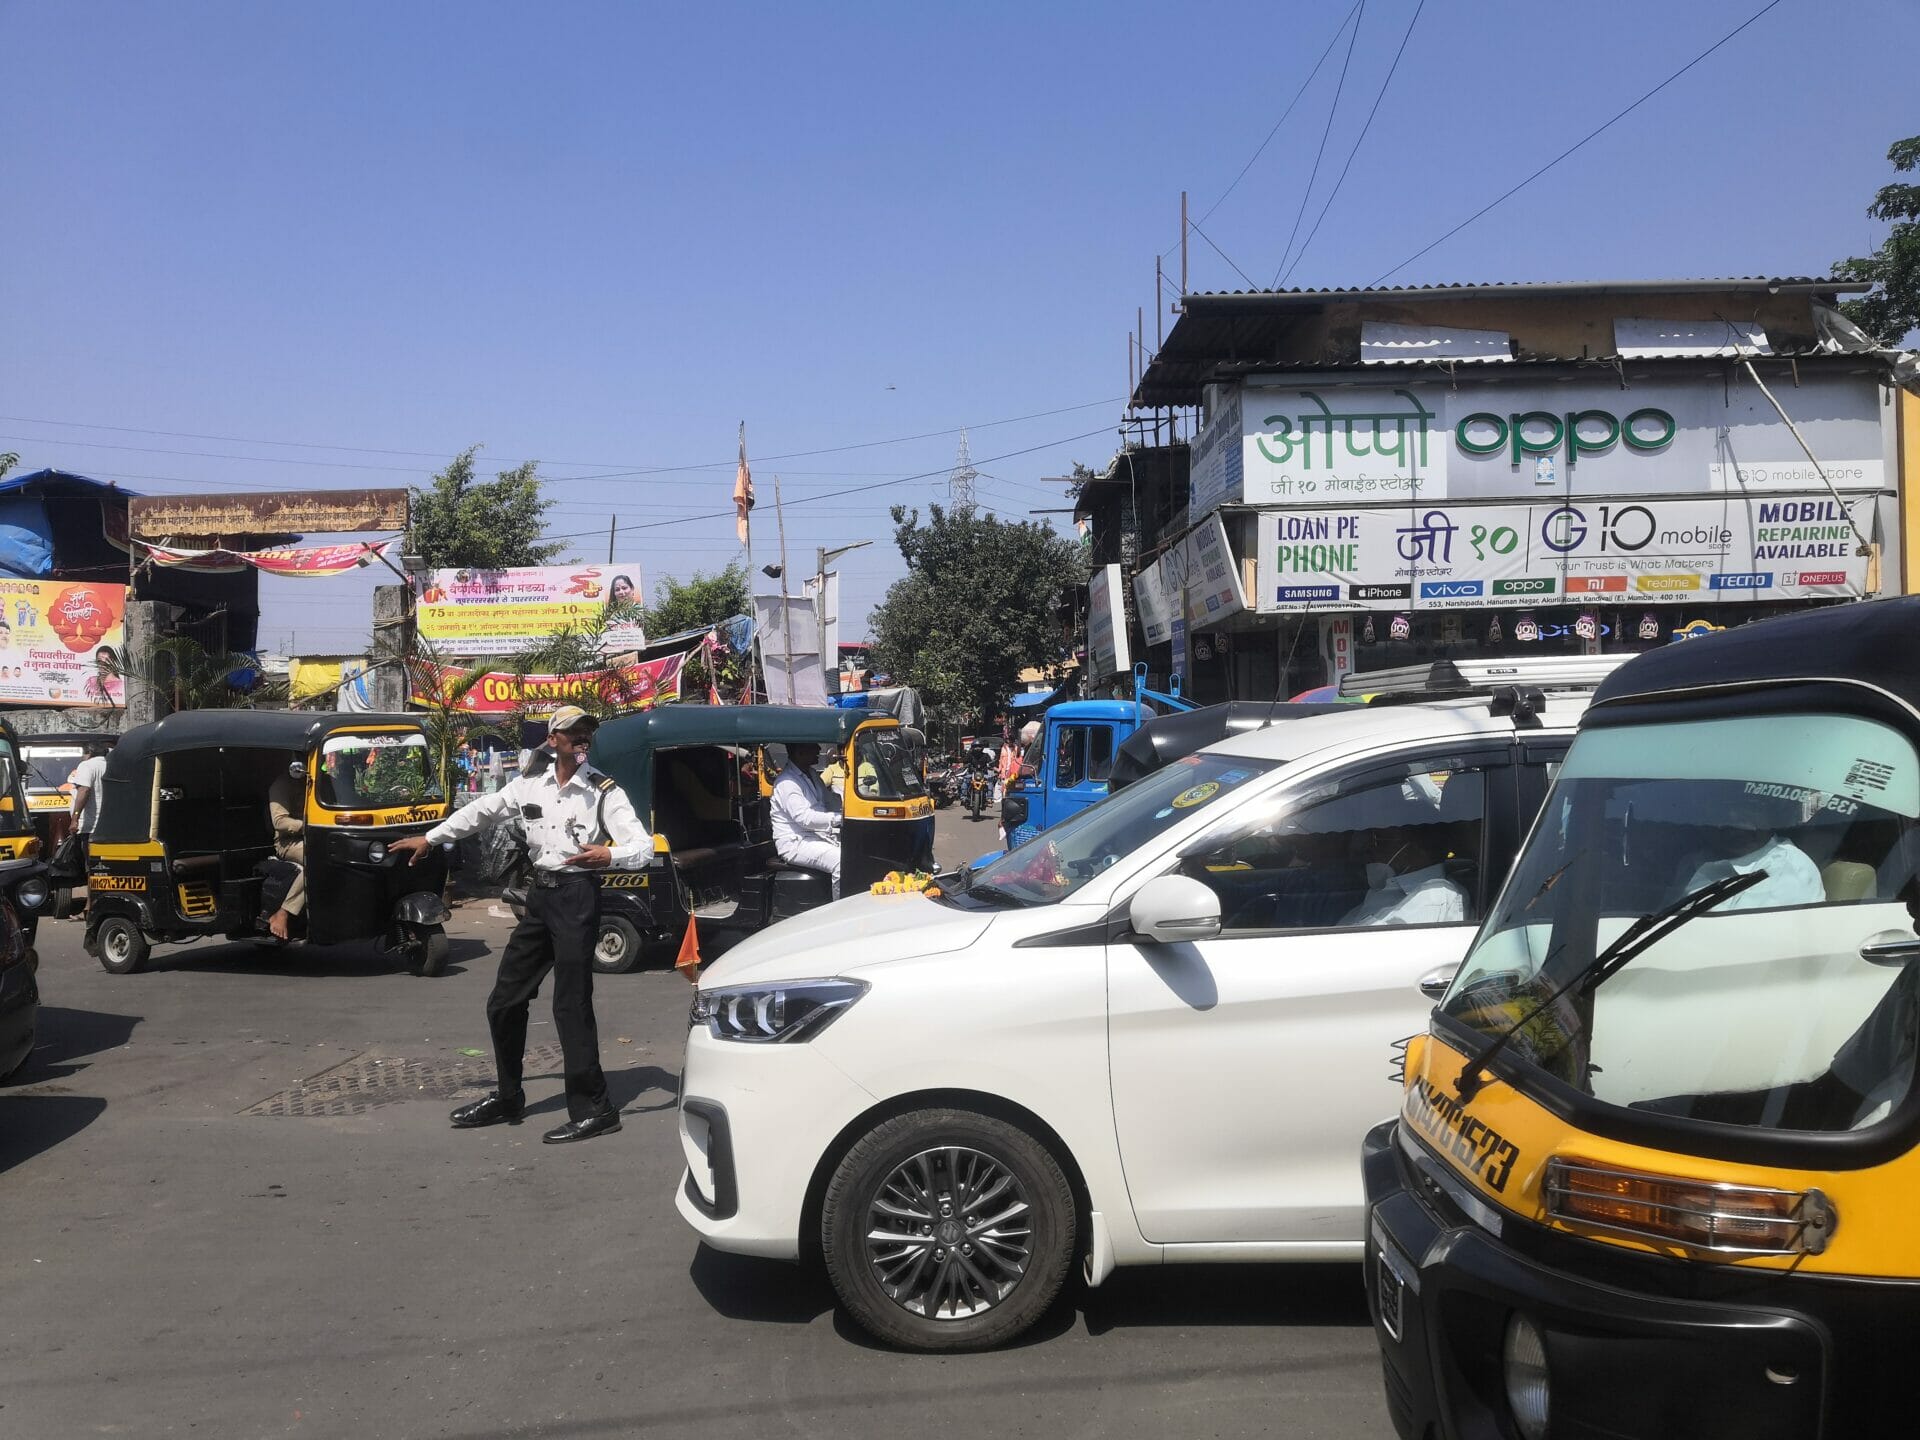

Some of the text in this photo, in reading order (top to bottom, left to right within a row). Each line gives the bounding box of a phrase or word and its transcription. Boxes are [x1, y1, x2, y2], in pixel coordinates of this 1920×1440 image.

[1256, 389, 1436, 470] ओप्पो
[1455, 407, 1676, 465] oppo
[1772, 468, 1815, 480] mobile
[1271, 475, 1294, 495] जी
[1298, 481, 1317, 494] १०
[1759, 501, 1854, 523] MOBILE
[1277, 516, 1360, 541] LOAN PE
[1757, 525, 1851, 543] REPAIRING
[1396, 510, 1519, 564] जी १०
[1660, 525, 1732, 545] mobile
[1754, 543, 1849, 560] AVAILABLE
[1277, 544, 1359, 574] PHONE
[1555, 559, 1714, 571] Your Trust is What Matters
[1647, 578, 1689, 588] realme
[1718, 575, 1765, 587] TECNO
[1802, 574, 1844, 583] ONEPLUS
[1426, 584, 1477, 596] vivo
[1503, 580, 1545, 592] oppo
[1284, 588, 1332, 598] SAMSUNG
[1367, 587, 1402, 598] iPhone
[1660, 593, 1673, 601] 400
[428, 608, 445, 617] 75
[562, 604, 578, 614] 10
[1392, 625, 1409, 633] JOY
[1519, 624, 1535, 634] JOY
[1578, 623, 1594, 632] JOY
[1640, 623, 1657, 632] JOY
